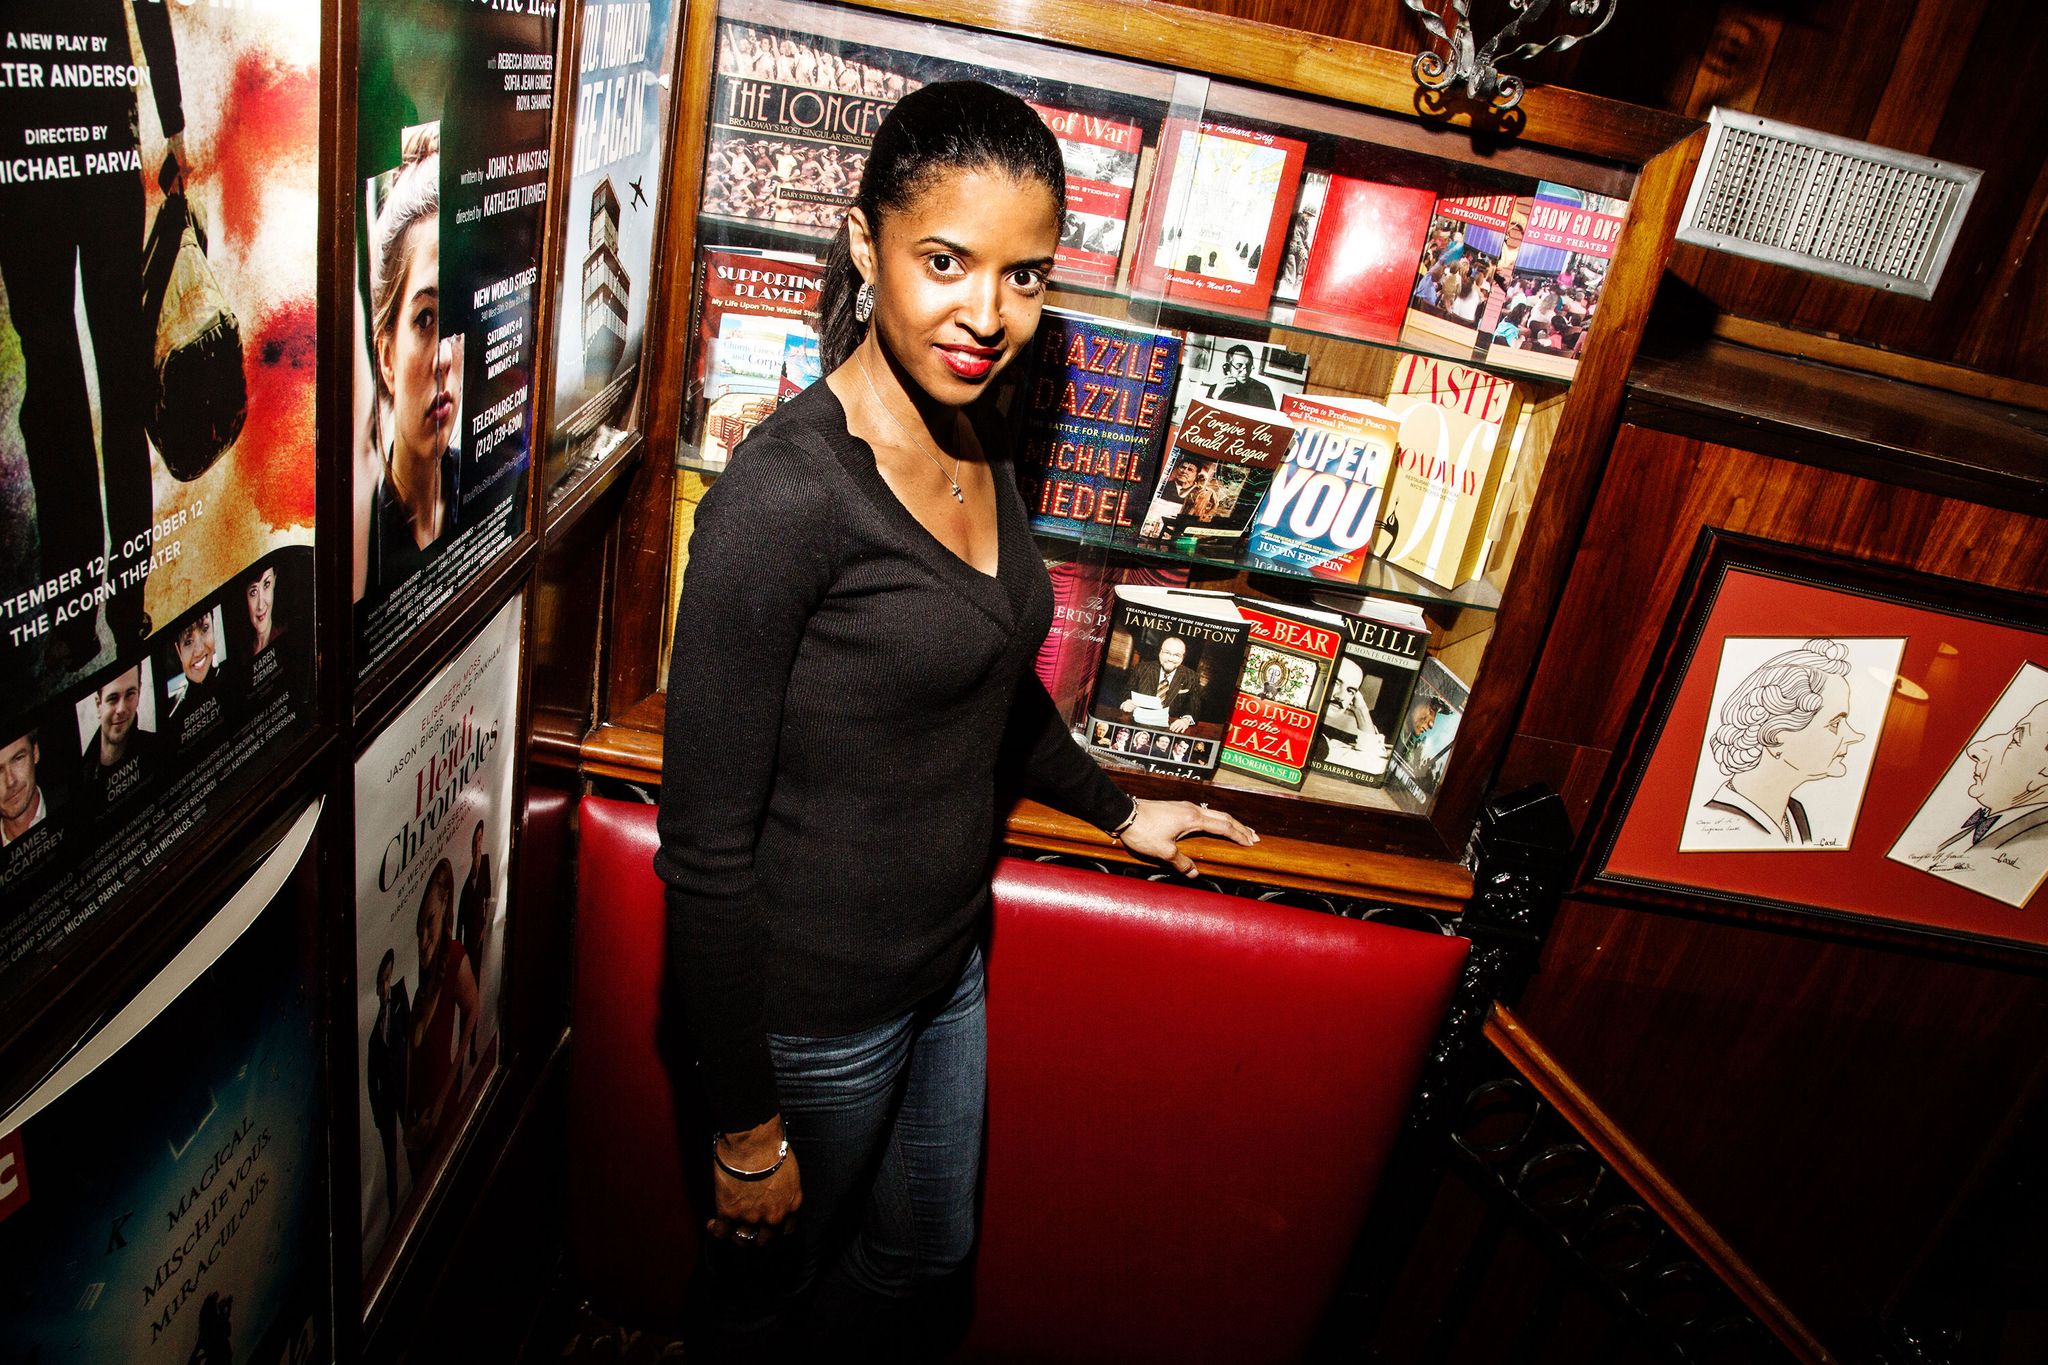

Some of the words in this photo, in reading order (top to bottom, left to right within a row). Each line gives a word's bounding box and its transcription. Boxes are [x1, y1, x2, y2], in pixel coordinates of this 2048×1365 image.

[6, 32, 19, 49] A
[20, 33, 52, 51] NEW
[56, 35, 88, 52] PLAY
[91, 36, 108, 52] BY
[602, 3, 650, 69] RONALD
[50, 64, 151, 88] ANDERSON
[497, 52, 523, 70] REBECCA
[523, 54, 553, 71] BROOKSHER
[503, 75, 520, 91] SOFIA
[521, 75, 534, 90] JEAN
[534, 74, 552, 90] GOMEZ
[516, 95, 530, 111] ROYA
[530, 93, 552, 110] SHANKS
[728, 80, 772, 121] THE
[779, 88, 896, 138] LONGES
[25, 126, 90, 145] DIRECTED
[92, 125, 108, 140] BY
[573, 71, 647, 178] REAGAN
[729, 117, 780, 132] BROADWAY'S
[779, 125, 802, 135] MOST
[802, 128, 841, 141] SINGULAR
[841, 134, 873, 146] SENSATI
[1051, 113, 1079, 134] of
[1083, 115, 1129, 144] War
[1215, 123, 1252, 139] Richard
[1252, 131, 1276, 145] Seff
[86, 150, 143, 176] PARVA
[460, 169, 478, 185] written
[478, 168, 484, 184] by
[485, 156, 507, 181] JOHN
[507, 155, 515, 175] S.
[516, 149, 549, 174] ANASTASI
[455, 207, 476, 224] directed
[475, 205, 482, 222] by
[483, 188, 521, 217] KATHLEEN
[521, 182, 547, 208] TURNER
[781, 190, 798, 199] GARY
[799, 193, 825, 202] STEVENS
[1466, 196, 1492, 212] DOES
[1492, 195, 1513, 217] THE
[1452, 207, 1507, 228] INTRODUCTION
[1531, 205, 1572, 232] SHOW
[1573, 214, 1592, 237] GO
[1593, 219, 1621, 243] ON?
[1528, 229, 1541, 239] TO
[1544, 233, 1563, 244] THE
[1566, 238, 1607, 252] THEATER
[474, 286, 490, 310] NEW
[491, 277, 514, 302] WORLD
[514, 266, 537, 291] STAGES
[716, 265, 827, 292] SUPPORTING
[735, 283, 807, 304] PLAYER
[1163, 273, 1194, 287] Illustrated
[1206, 281, 1223, 291] Mark
[711, 298, 723, 308] My
[724, 300, 739, 309] Life
[740, 302, 760, 312] Upon
[761, 304, 775, 313] The
[776, 306, 803, 316] Wicked
[487, 320, 516, 345] SATURDAYS
[485, 341, 509, 365] SUNDAYS
[487, 356, 512, 380] MONDAYS
[1042, 328, 1169, 384] RAZZLE
[1033, 376, 1159, 429] DAZZLE
[1396, 354, 1510, 425] TASTE
[472, 385, 528, 436] TELECHARGE.COM
[1289, 411, 1303, 420] and
[1304, 413, 1337, 428] Personal
[1338, 422, 1363, 434] Power
[1292, 400, 1298, 409] 7
[1298, 402, 1319, 415] Steps
[1328, 410, 1364, 425] Profound
[1365, 418, 1388, 431] Peace
[475, 433, 494, 463] (212)
[494, 413, 523, 447] 239-6200
[1081, 426, 1099, 437] FOR
[1102, 431, 1150, 445] BROADWAY
[1199, 411, 1246, 437] Forgive
[1252, 424, 1273, 446] You,
[1180, 425, 1225, 452] Ronald
[1225, 443, 1270, 465] Reagan
[1284, 427, 1384, 488] SUPER
[1258, 462, 1384, 551] YOU
[86, 557, 106, 579] 12
[123, 510, 188, 560] OCTOBER
[190, 499, 204, 521] 12
[1257, 541, 1296, 559] JUSTIN
[1297, 552, 1343, 572] EPSTEIN
[10, 612, 51, 648] THE
[55, 580, 117, 627] ACORN
[120, 540, 182, 590] THEATER
[1125, 607, 1147, 615] CREATOR
[1125, 612, 1173, 632] JAMES
[1178, 623, 1236, 644] LIPTON
[1250, 620, 1270, 637] The
[1273, 621, 1329, 654] BEAR
[253, 648, 276, 673] KAREN
[1354, 647, 1380, 659] MONTE
[1381, 654, 1410, 667] CRISTO
[253, 660, 278, 687] ZIEMBA
[421, 680, 461, 731] ELISABETH
[463, 654, 481, 681] MOSS
[180, 705, 221, 745] PRESSLEY
[184, 696, 217, 729] BRENDA
[1236, 696, 1260, 714] HO
[1262, 704, 1312, 729] LIVED
[1241, 718, 1257, 727] at
[1258, 720, 1281, 735] the
[387, 744, 417, 783] JASON
[420, 714, 444, 749] BIGGS
[451, 680, 472, 712] BRYCE
[440, 722, 460, 756] The
[106, 756, 139, 790] JONNY
[415, 705, 475, 823] Heidi
[1233, 754, 1287, 777] MOREHOUSE
[1288, 769, 1299, 781] III
[1323, 764, 1355, 779] BARBARA
[1355, 772, 1375, 783] GELB
[107, 770, 140, 802] ORSINI
[173, 805, 190, 822] ROSE
[378, 719, 499, 893] Chronicles
[9, 827, 48, 864] JAMES
[142, 845, 161, 867] LEAH
[160, 817, 194, 851] MICHALOS,
[97, 864, 118, 888] DREW
[119, 840, 147, 870] FRANCIS
[407, 845, 433, 884] WENDY
[63, 901, 100, 935] MICHAEL
[97, 880, 125, 905] PARVA,
[390, 880, 419, 923] DIRECTED
